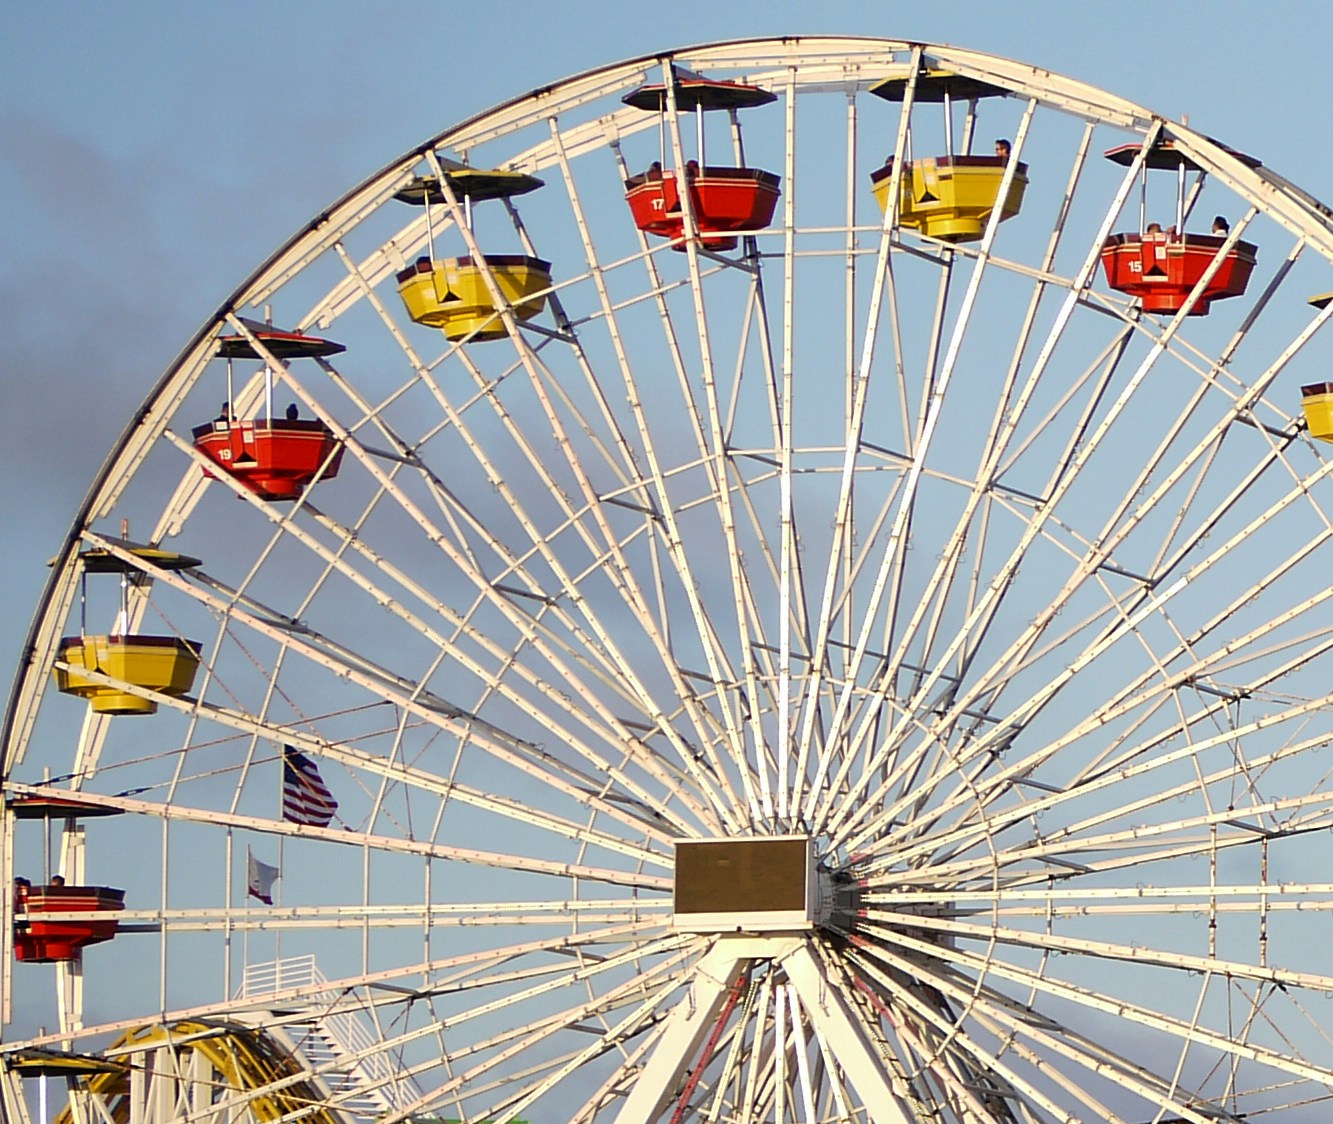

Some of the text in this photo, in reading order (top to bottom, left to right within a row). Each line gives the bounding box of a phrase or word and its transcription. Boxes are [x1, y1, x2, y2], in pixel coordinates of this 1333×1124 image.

[651, 198, 665, 210] 17
[1128, 260, 1143, 273] 15
[217, 448, 232, 460] 19
